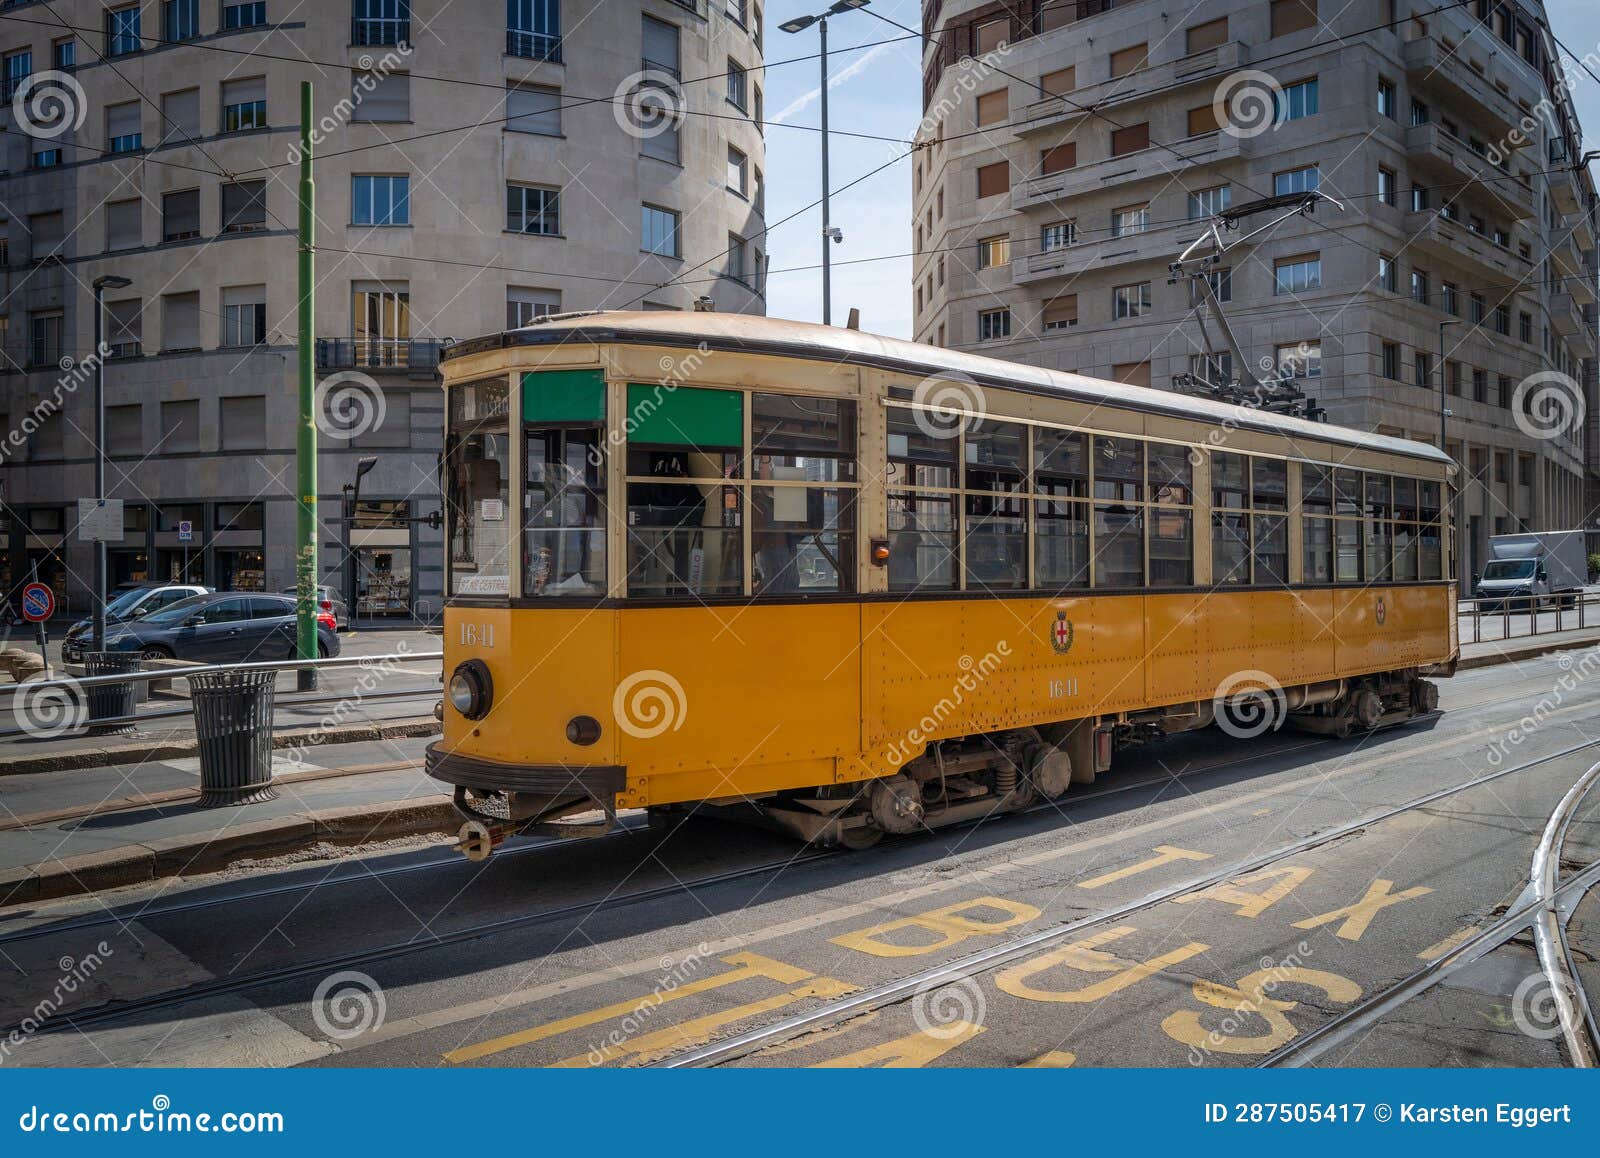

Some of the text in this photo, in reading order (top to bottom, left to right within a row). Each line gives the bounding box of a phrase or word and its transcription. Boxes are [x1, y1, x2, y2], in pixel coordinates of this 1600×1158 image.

[460, 622, 495, 648] 1641
[1049, 678, 1078, 698] 1641
[829, 896, 1363, 1055] BUS
